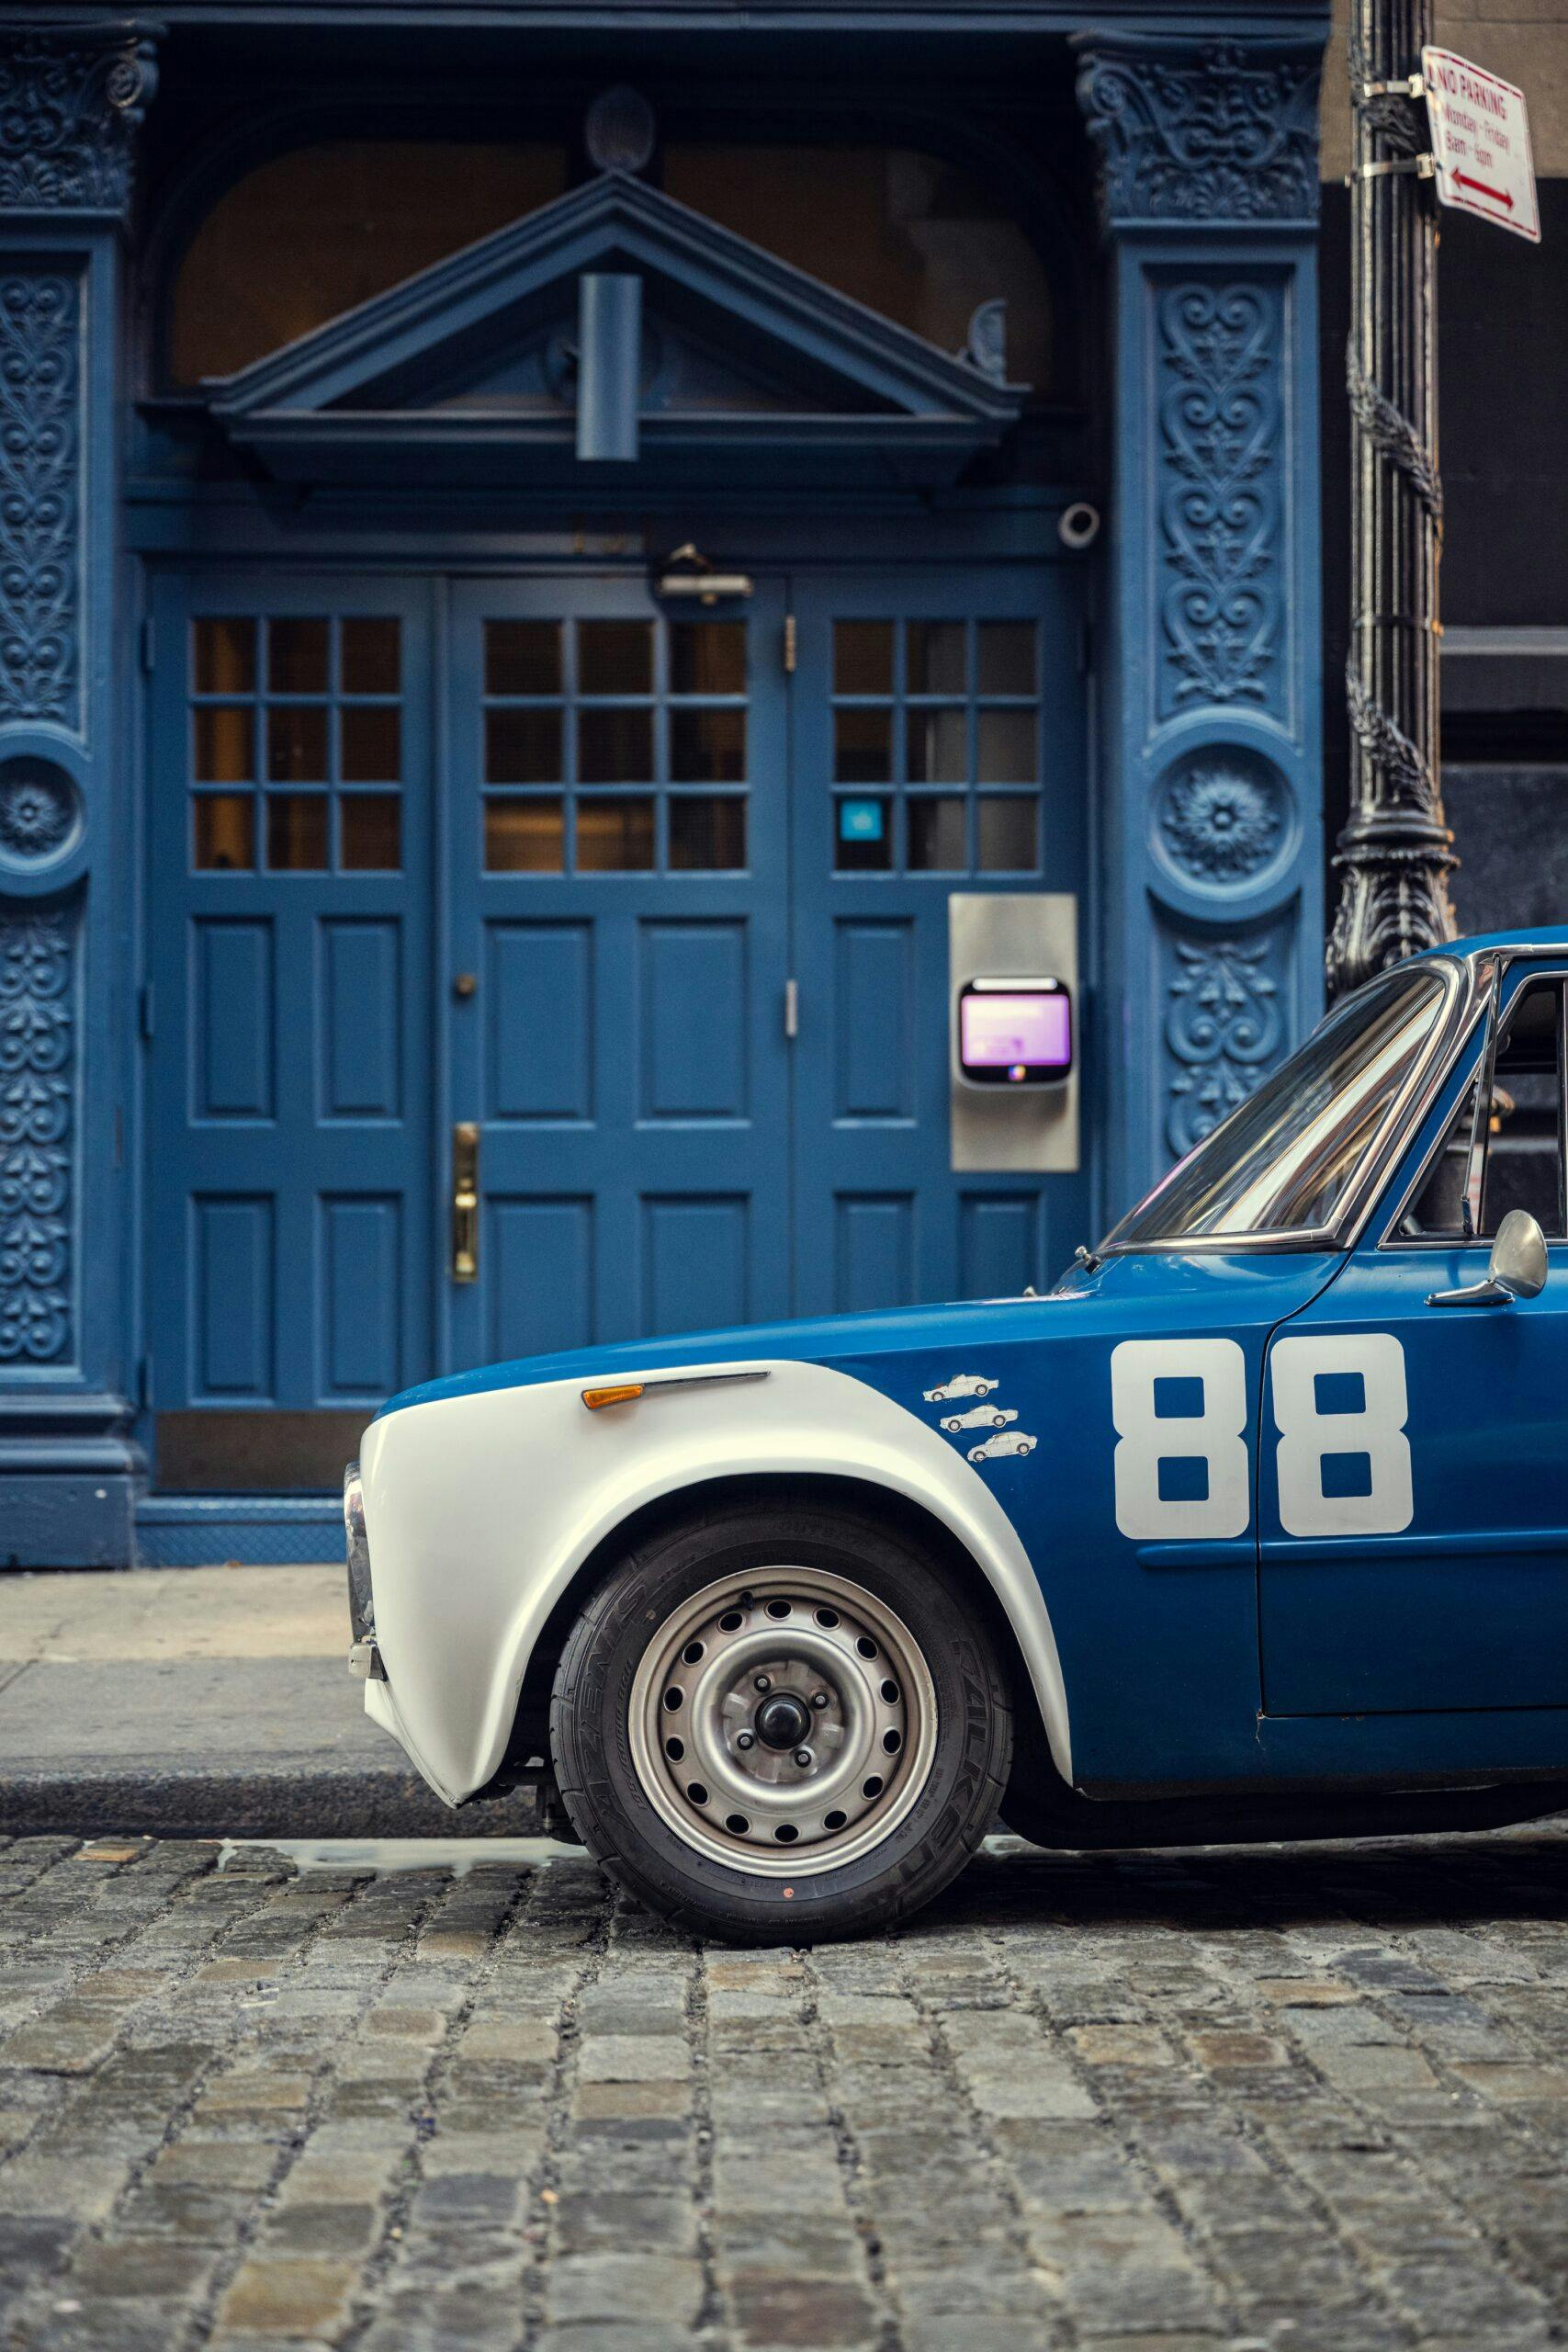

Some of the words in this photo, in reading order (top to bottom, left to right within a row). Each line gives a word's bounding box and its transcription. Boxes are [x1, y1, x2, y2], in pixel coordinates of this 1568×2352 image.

[1438, 66, 1456, 95] NO
[1460, 74, 1507, 120] PARKING
[1445, 103, 1477, 137] Monday
[1111, 1333, 1414, 1540] 88
